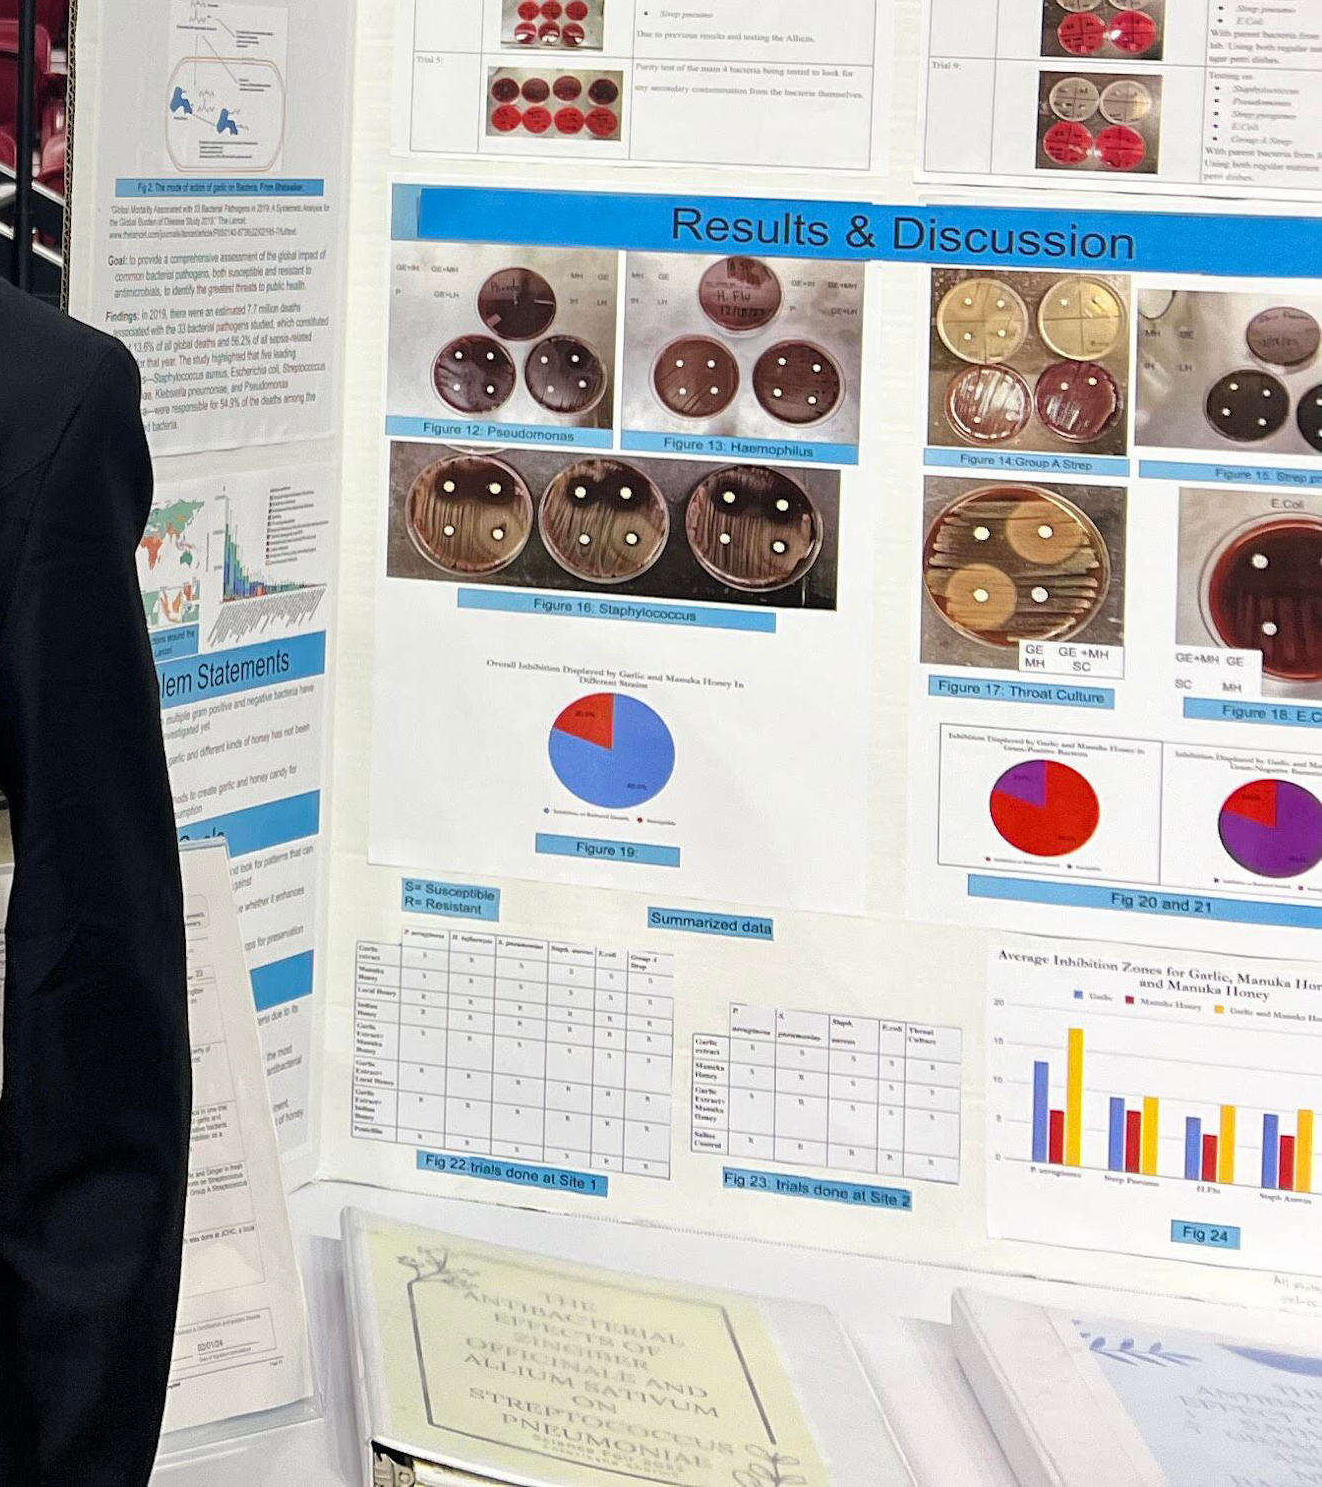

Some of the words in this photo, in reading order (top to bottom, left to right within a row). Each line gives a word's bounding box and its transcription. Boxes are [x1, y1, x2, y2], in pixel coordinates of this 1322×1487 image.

[673, 208, 829, 246] Results
[846, 215, 875, 248] &
[894, 217, 1133, 259] Discussion
[938, 680, 981, 696] Figure
[1009, 685, 1053, 700] Throat
[1057, 689, 1105, 704] Culture
[1111, 893, 1133, 908] Fig
[1139, 895, 1157, 908] 20
[1162, 900, 1189, 912] and
[1194, 900, 1211, 913] 21
[651, 912, 737, 931] Summarized
[742, 921, 771, 934] data
